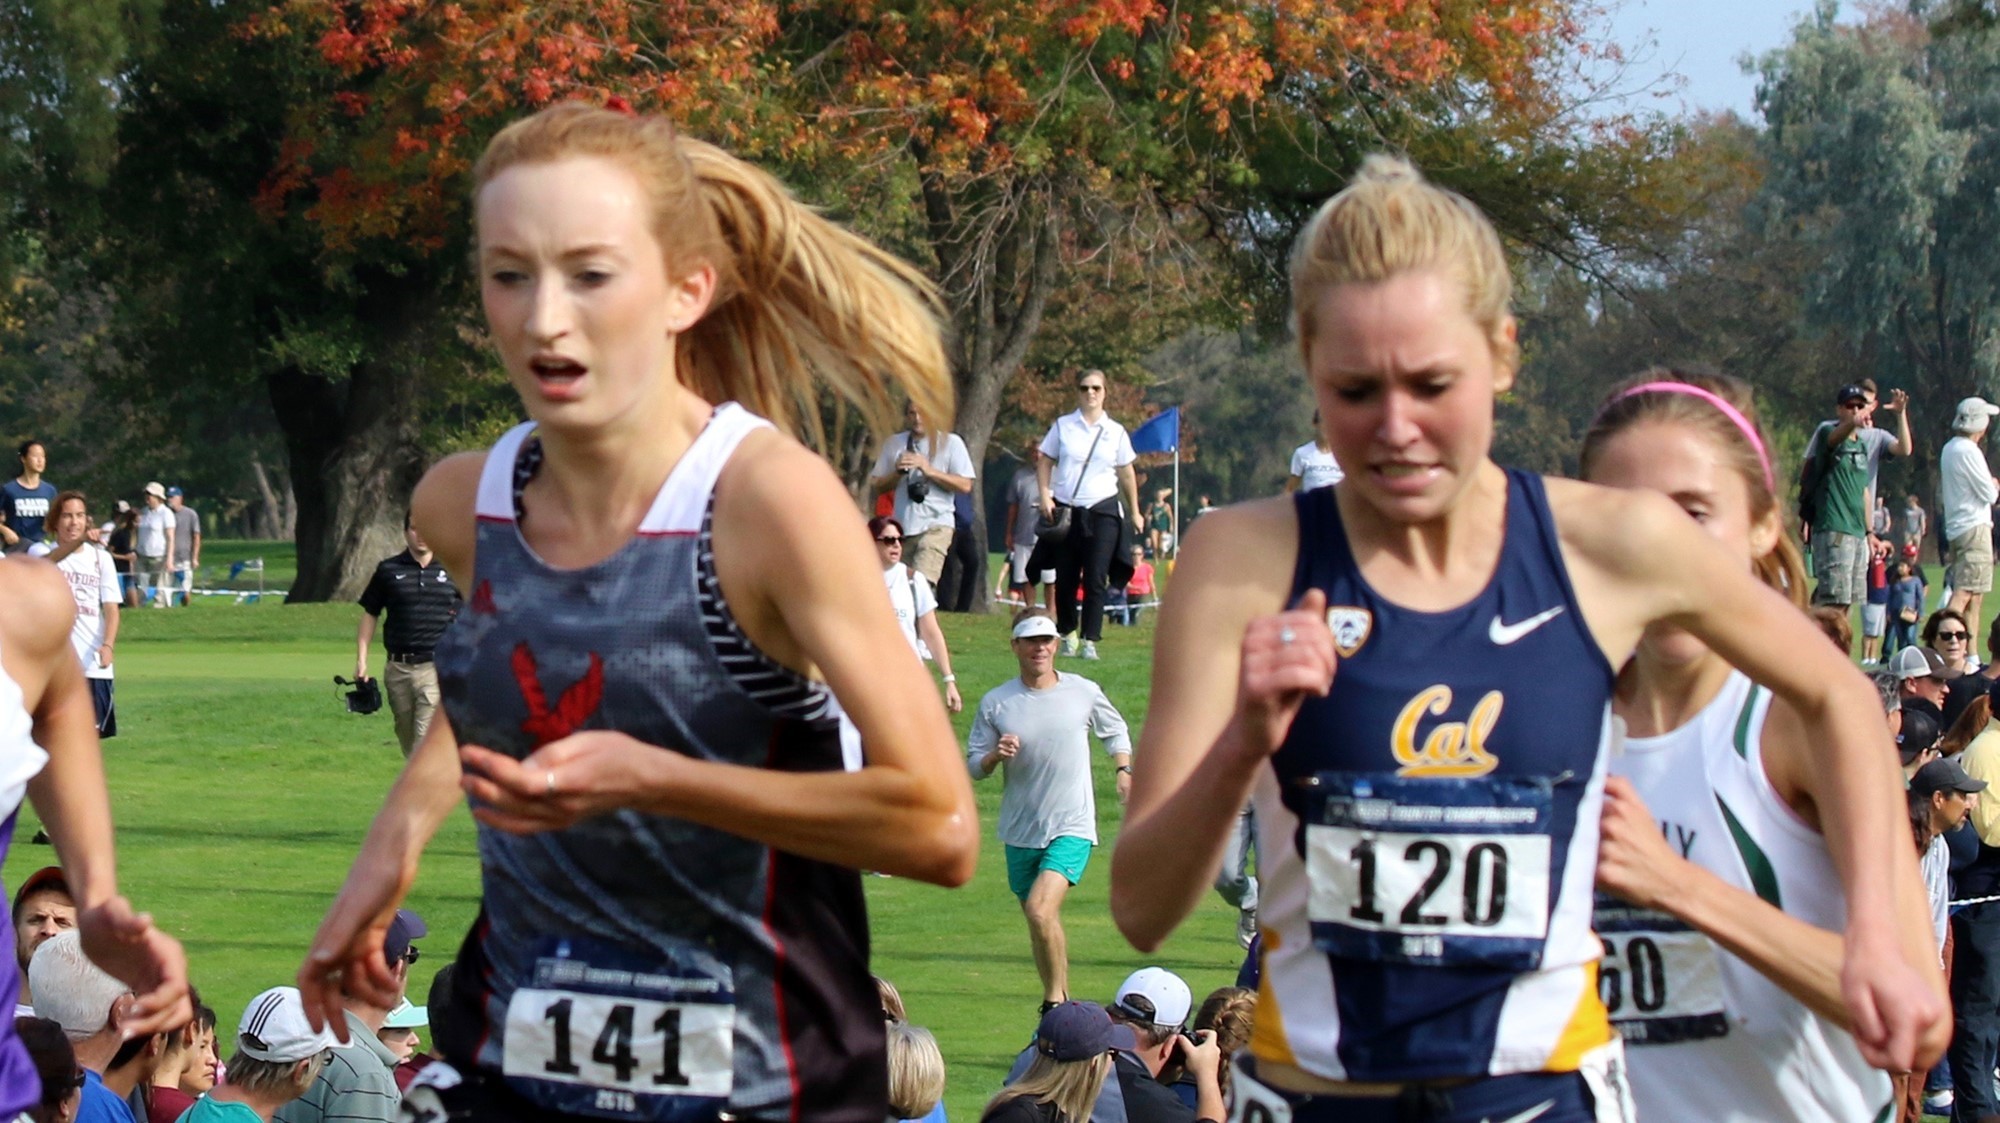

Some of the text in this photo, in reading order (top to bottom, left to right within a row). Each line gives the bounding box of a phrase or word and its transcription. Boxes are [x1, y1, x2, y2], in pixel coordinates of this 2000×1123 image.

[1391, 684, 1503, 777] Cal
[1349, 838, 1508, 927] 120
[545, 998, 689, 1087] 141
